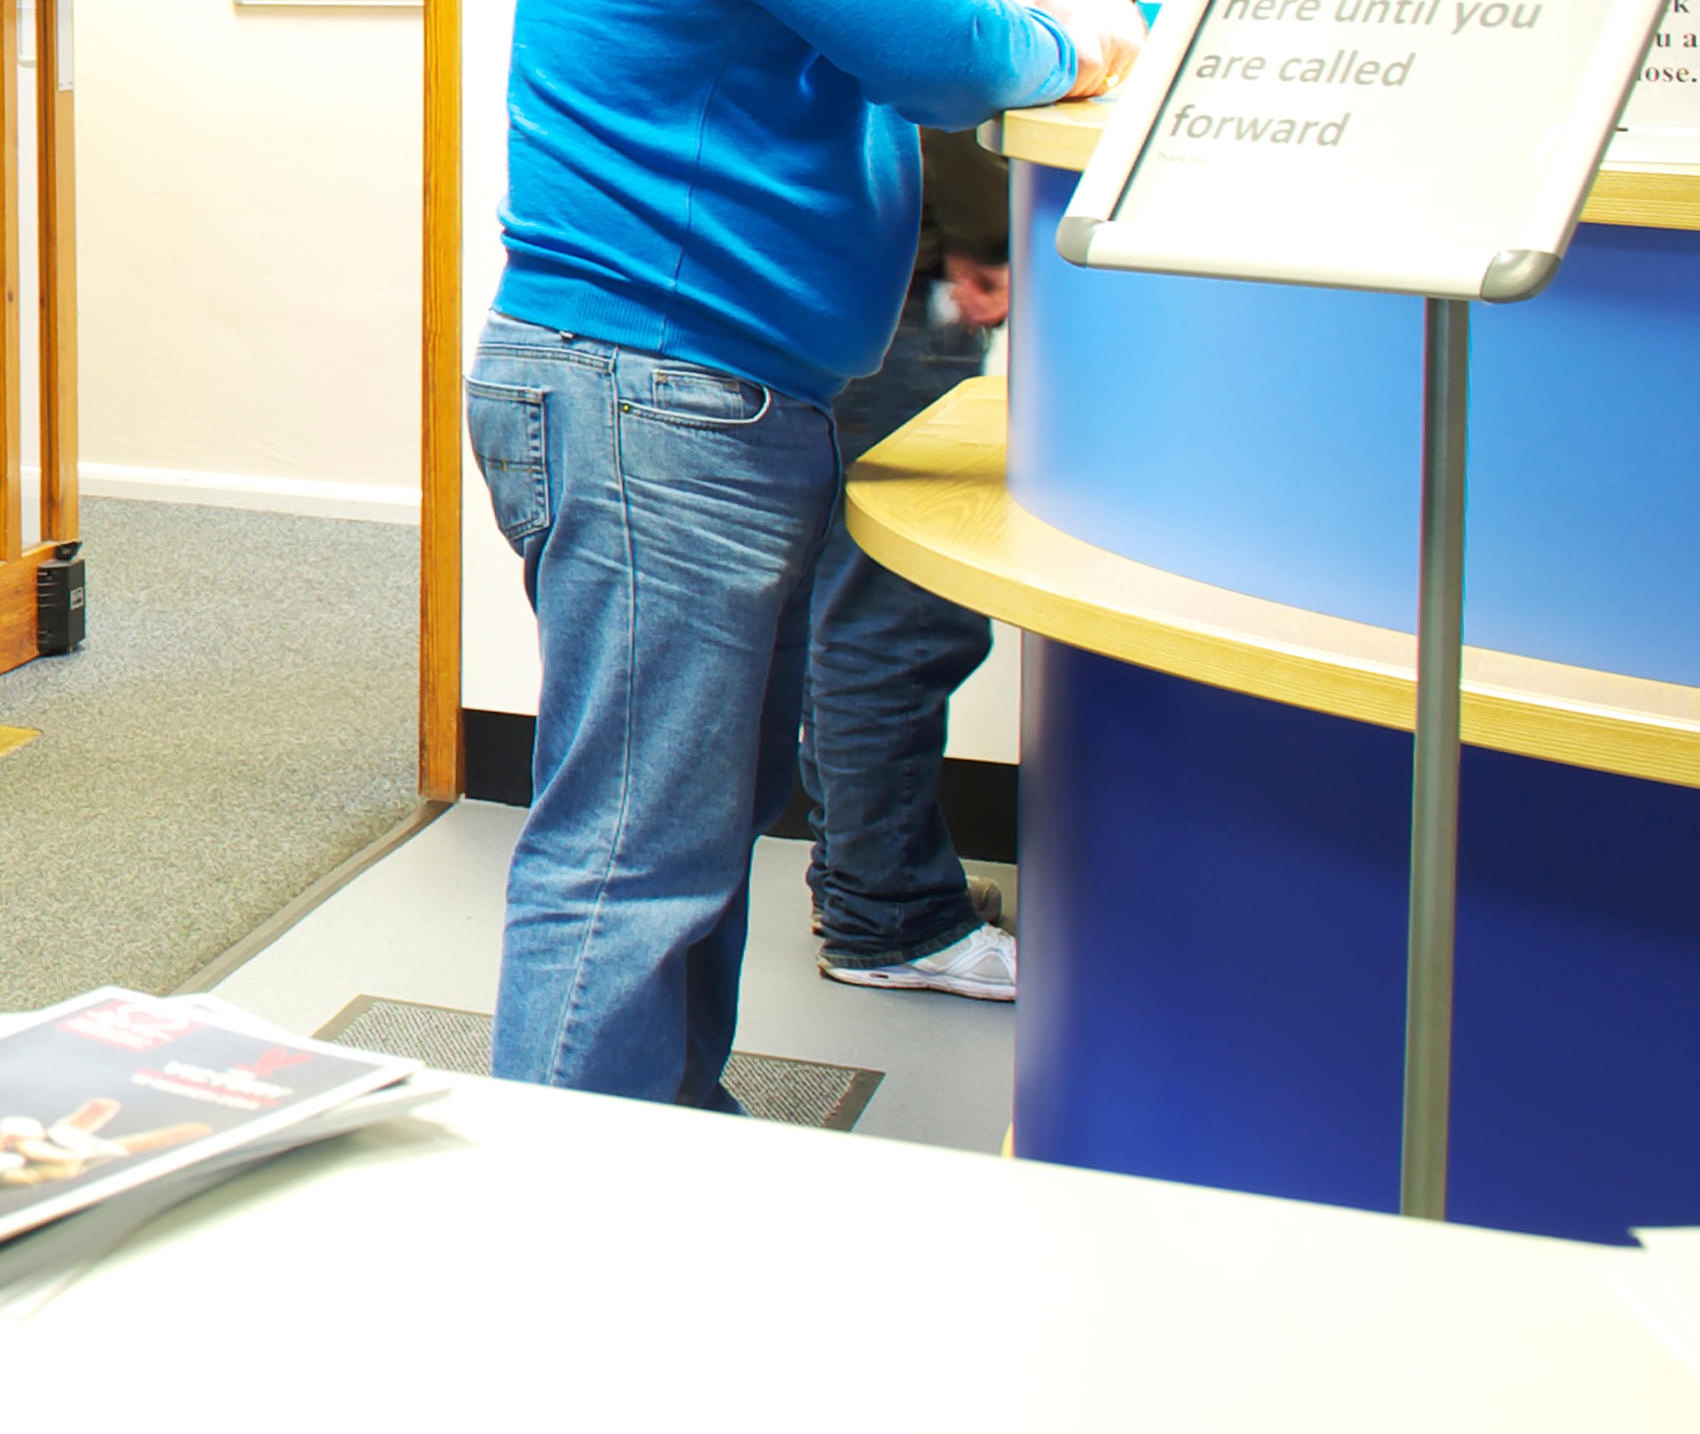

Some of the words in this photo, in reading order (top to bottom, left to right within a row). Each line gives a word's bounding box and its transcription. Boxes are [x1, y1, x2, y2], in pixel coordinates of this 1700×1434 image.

[1451, 0, 1543, 34] you
[1196, 54, 1268, 82] are
[1277, 49, 1417, 87] called
[1168, 103, 1351, 149] forward
